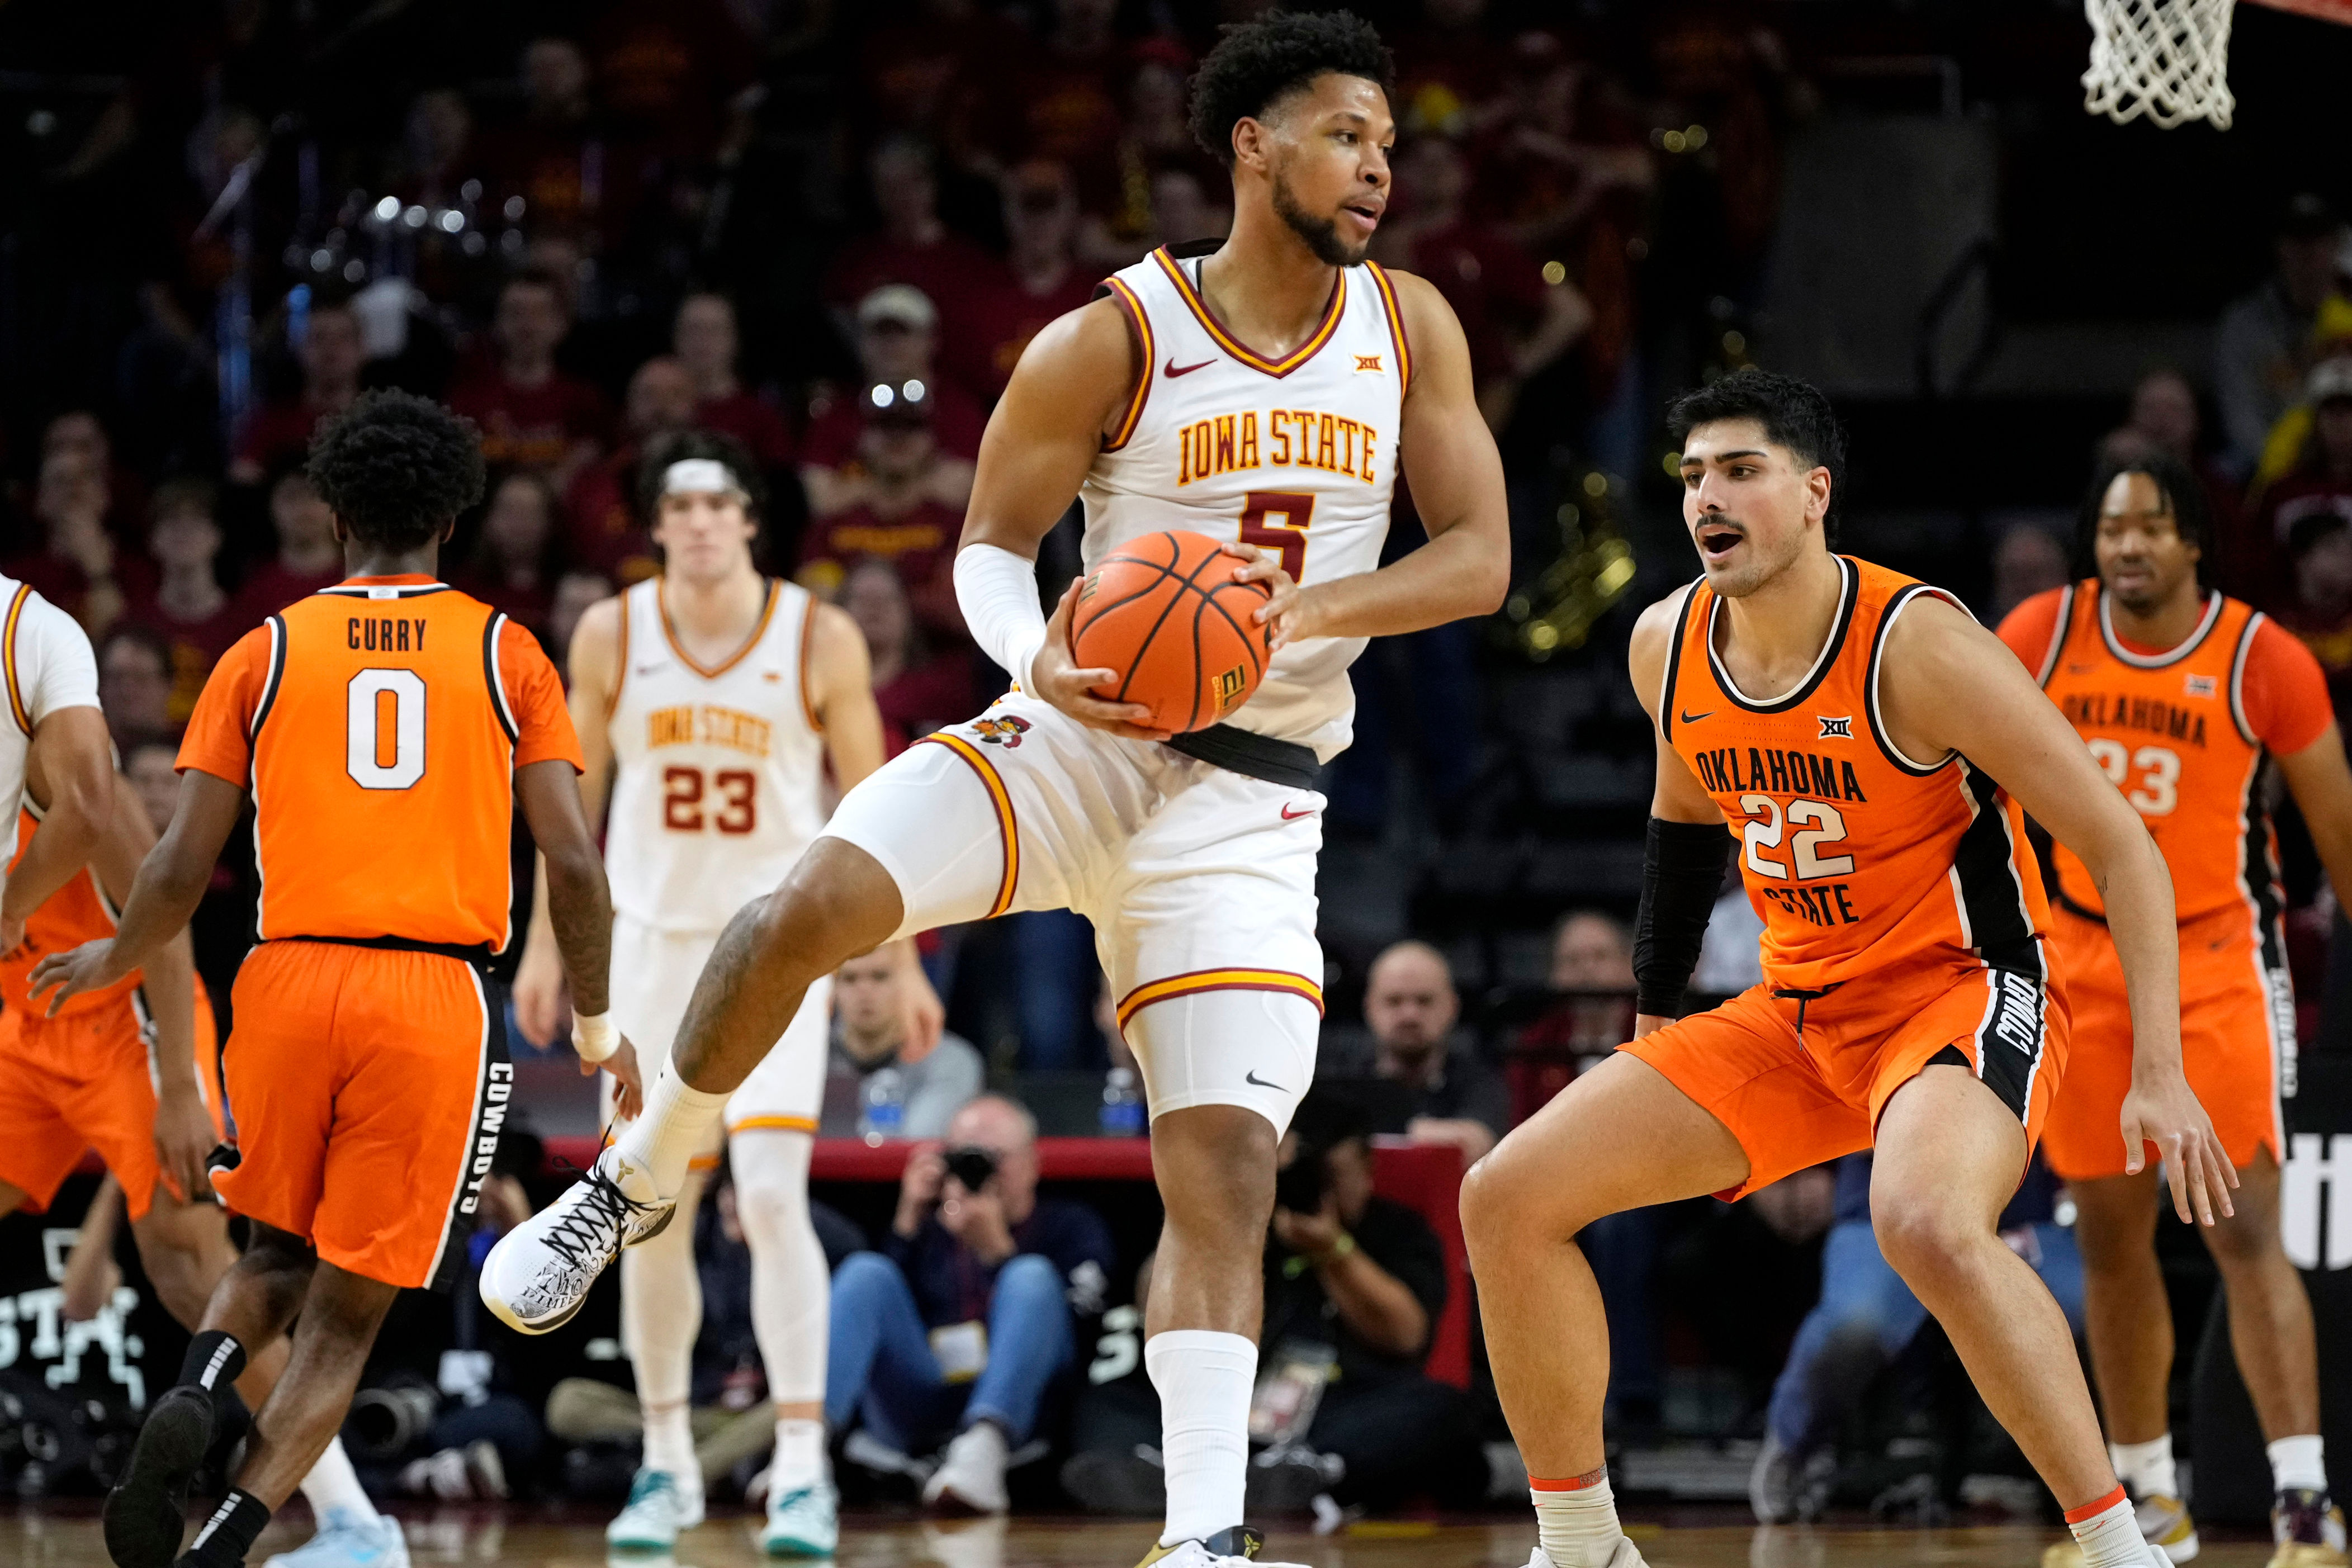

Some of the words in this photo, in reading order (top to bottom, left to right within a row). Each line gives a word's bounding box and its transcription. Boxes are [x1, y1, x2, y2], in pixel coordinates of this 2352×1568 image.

[1177, 410, 1261, 486] IOWA
[1269, 409, 1378, 485] STATE
[1237, 491, 1316, 587] 5
[348, 617, 426, 652] CURRY
[346, 667, 427, 790] 0
[1820, 718, 1851, 736] XII
[664, 766, 755, 833] 23
[1695, 747, 1867, 803] OKLAHOMA
[1738, 794, 1855, 881] 22
[1762, 884, 1859, 927] STATE
[460, 1062, 514, 1214] COWBOYS
